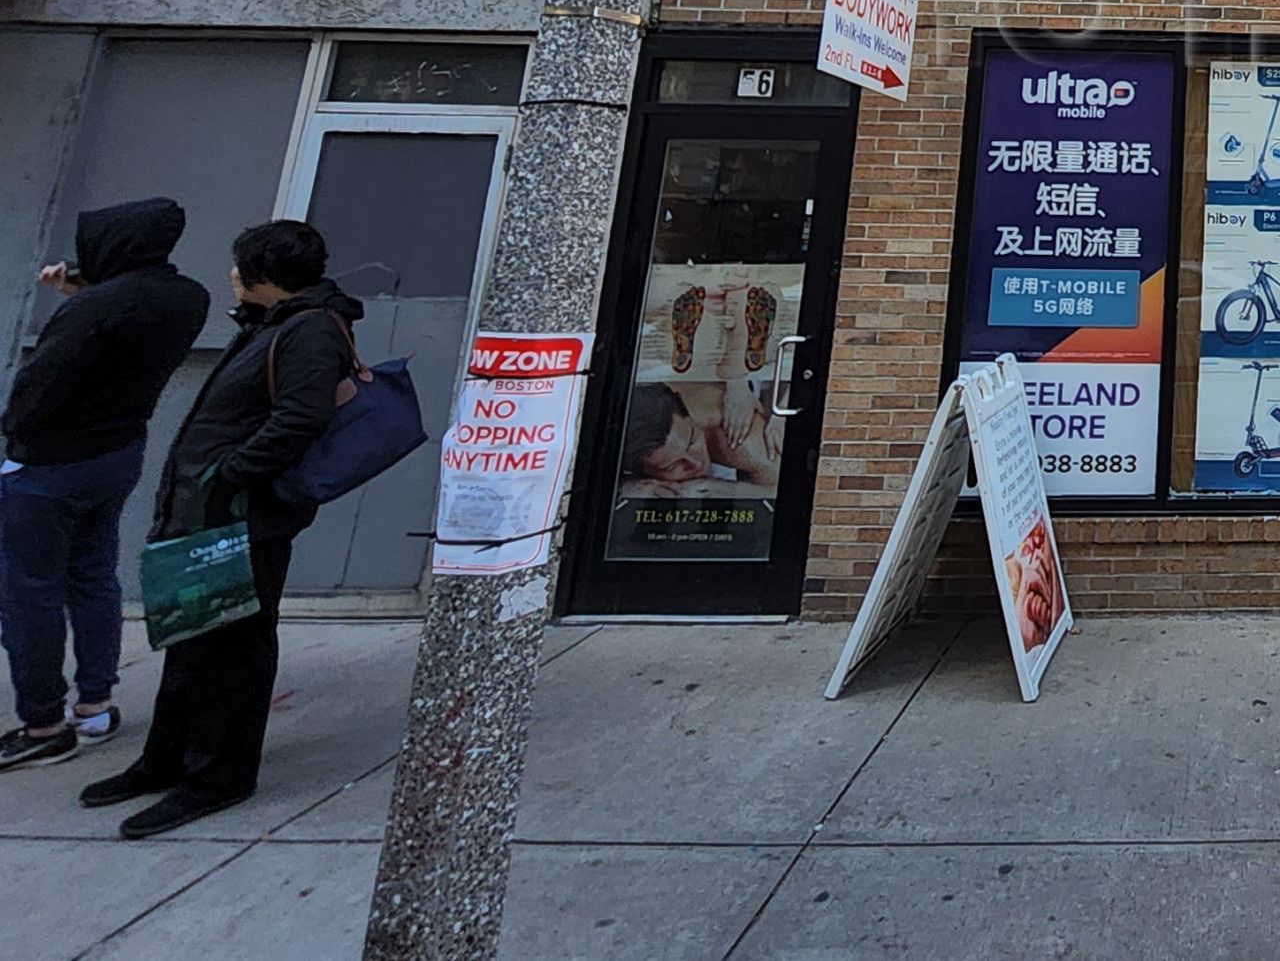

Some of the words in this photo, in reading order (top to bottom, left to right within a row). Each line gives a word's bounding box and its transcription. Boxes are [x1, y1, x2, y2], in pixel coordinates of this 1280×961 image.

[835, 14, 872, 49] Walk-Ins
[873, 34, 907, 65] Welcome
[824, 44, 843, 66] 2nd
[1212, 69, 1251, 82] hiboy
[1022, 71, 1108, 107] ultra
[1057, 106, 1106, 119] mobile
[987, 140, 1160, 176] 无限量通话、
[1035, 182, 1106, 218] 短信、
[1207, 212, 1247, 227] hiboy
[1263, 212, 1277, 222] P6
[994, 225, 1142, 257] 及上网流量
[499, 350, 573, 371] ZONE
[495, 380, 555, 391] BOSTON
[1023, 382, 1141, 407] EELAND
[473, 399, 516, 419] NO
[457, 424, 556, 446] OPPING
[1030, 414, 1106, 439] TORE
[444, 447, 549, 472] ANYTIME
[1039, 454, 1137, 473] 38-8883
[634, 510, 662, 524] TEL:
[665, 510, 755, 524] 617-728-7888
